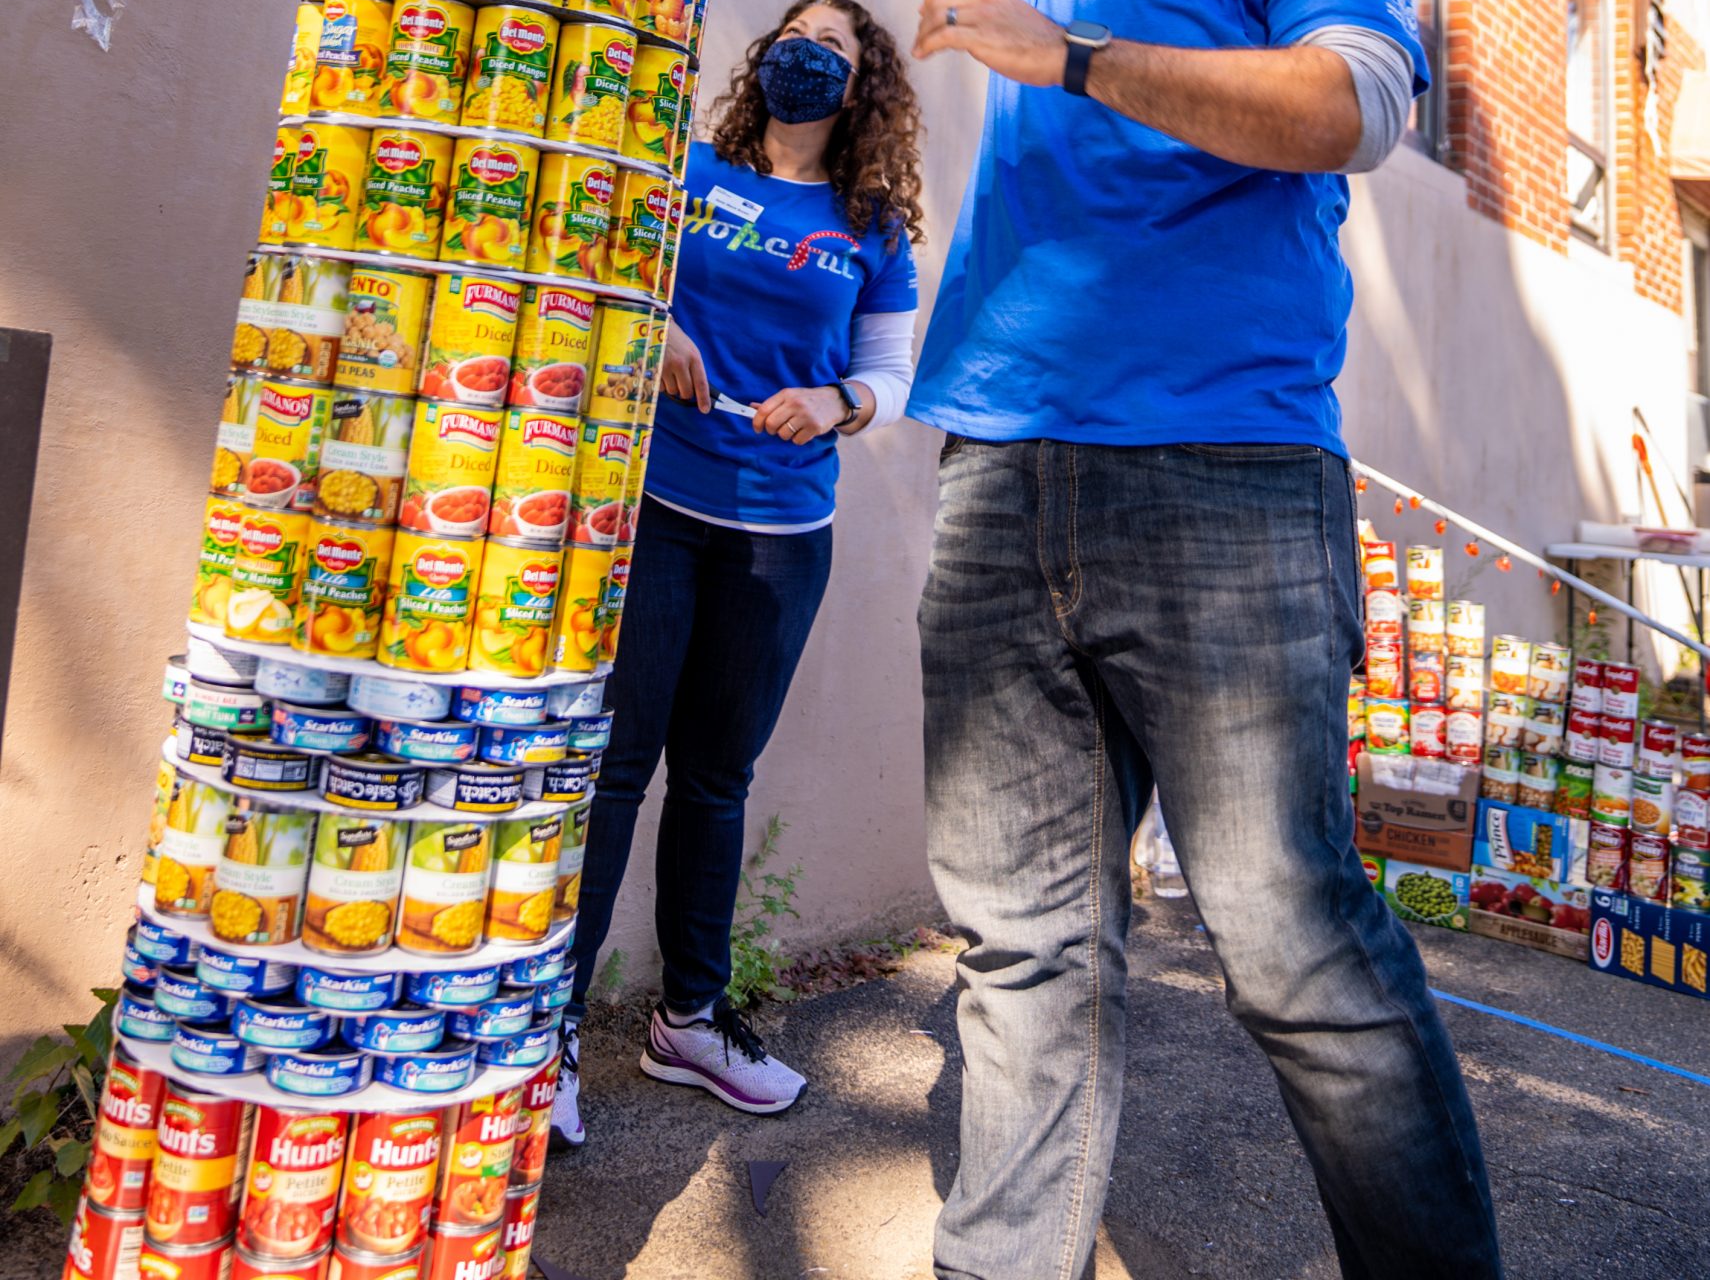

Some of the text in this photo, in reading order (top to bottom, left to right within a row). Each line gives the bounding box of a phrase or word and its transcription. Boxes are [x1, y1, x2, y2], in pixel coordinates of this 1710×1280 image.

[401, 15, 444, 28] Del Monte
[501, 26, 545, 43] Del Monte
[326, 51, 356, 61] Peaches
[608, 47, 620, 58] Del
[413, 54, 449, 67] Peaches
[488, 59, 547, 78] Diced Mangos
[595, 79, 617, 91] Diced
[378, 147, 420, 160] Del Monte
[471, 157, 518, 173] Del Monte
[389, 183, 426, 196] Peaches
[587, 177, 600, 188] Del
[457, 191, 522, 208] Sliced Peaches
[648, 195, 659, 206] Del
[571, 214, 597, 226] Sliced
[633, 228, 656, 240] Sliced
[475, 324, 513, 343] Diced
[551, 331, 588, 350] Diced
[350, 368, 375, 378] PEAS
[450, 454, 492, 471] Diced
[253, 530, 282, 544] Monte
[318, 544, 362, 559] Del Monte
[417, 558, 464, 573] Del Monte
[523, 570, 538, 582] Del
[328, 585, 367, 600] Peaches
[401, 597, 467, 615] Sliced Peaches
[506, 606, 534, 619] Sliced
[502, 696, 544, 707] StarKist
[302, 719, 354, 733] StarKist
[409, 729, 459, 743] StarKist
[366, 783, 397, 801] Safe
[1388, 829, 1436, 846] CHICKEN
[1492, 813, 1507, 859] Prince
[1595, 896, 1611, 907] 6
[1597, 921, 1608, 957] Barilla
[319, 975, 372, 992] StarKist
[452, 972, 495, 986] StarKist
[253, 1013, 304, 1029] StarKist
[284, 1059, 335, 1076] StarKist
[113, 1134, 152, 1148] Sauce
[286, 1174, 328, 1190] Petite
[386, 1174, 425, 1188] Petite
